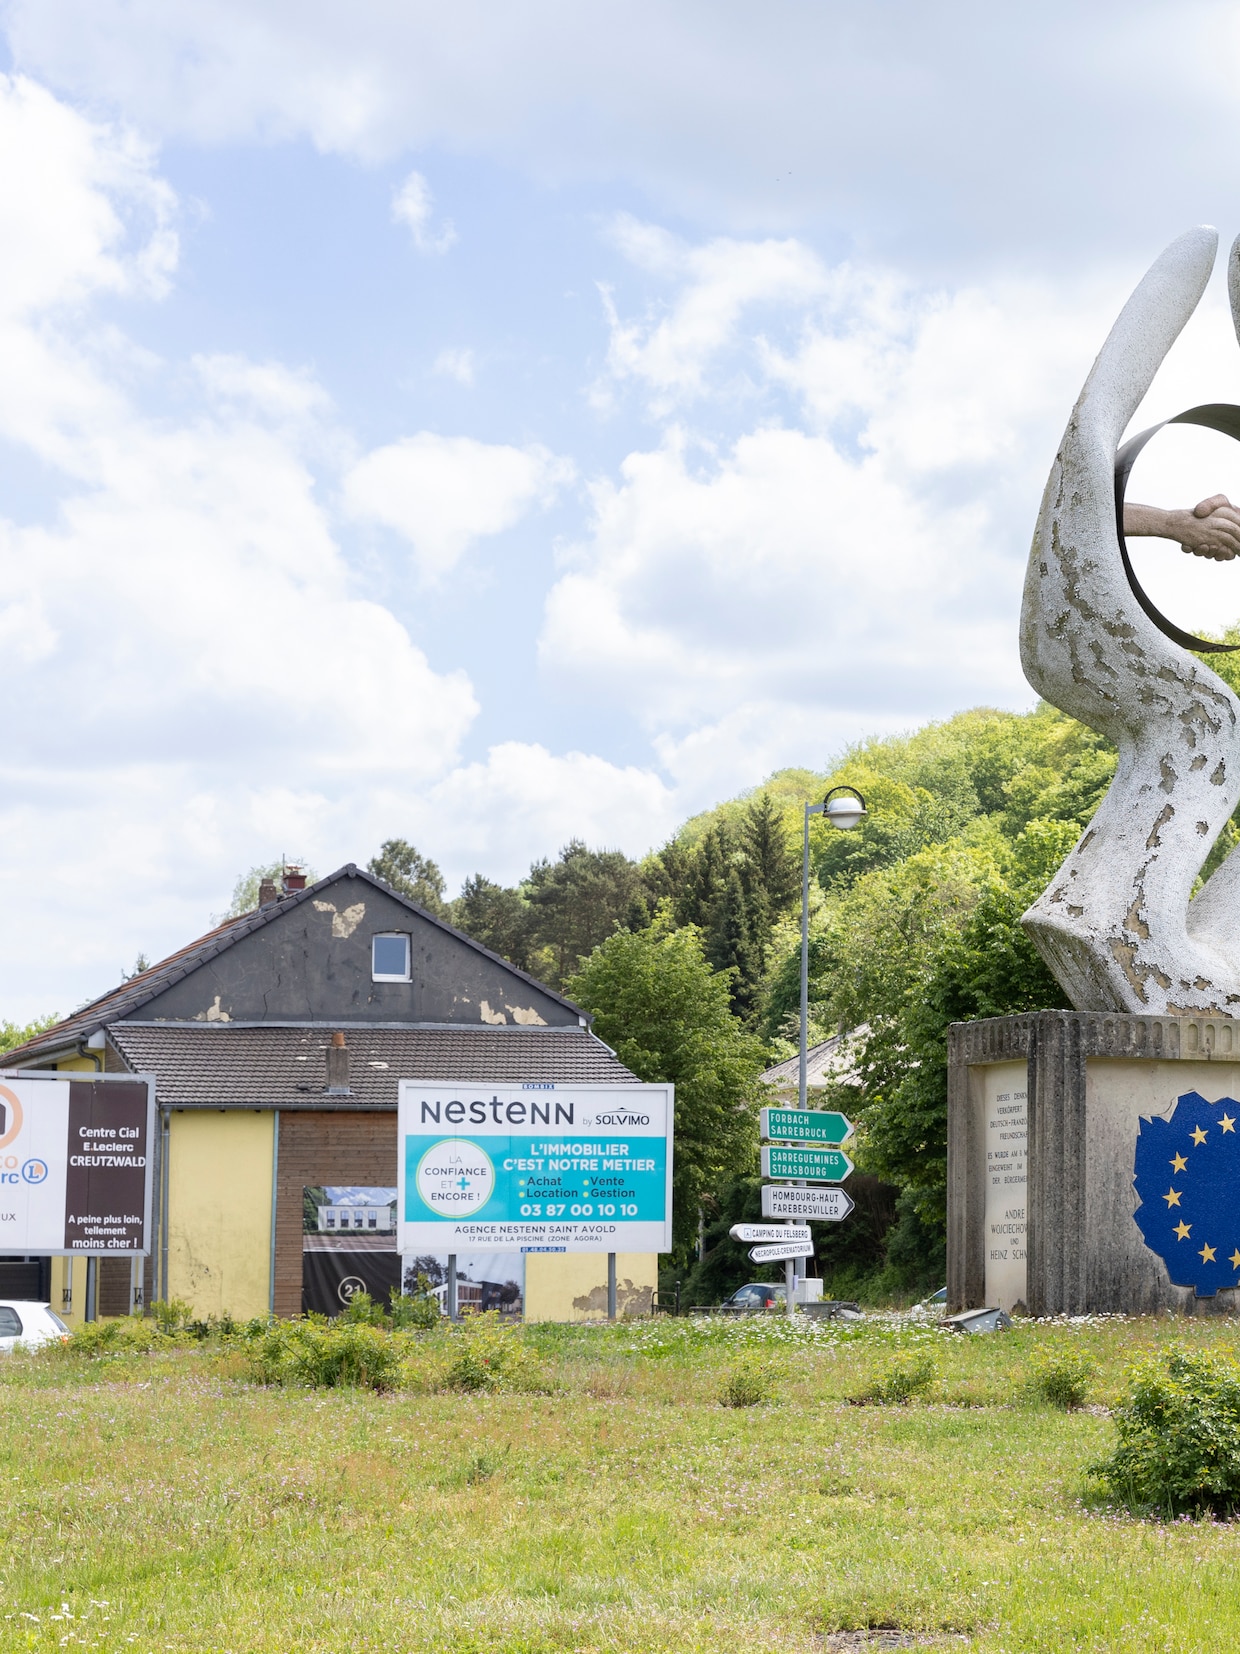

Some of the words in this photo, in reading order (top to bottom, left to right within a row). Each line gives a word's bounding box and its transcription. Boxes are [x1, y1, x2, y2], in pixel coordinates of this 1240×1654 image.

[996, 1094, 1010, 1102] DIESES
[582, 1117, 593, 1127] by
[595, 1114, 650, 1126] SOLVIMO
[770, 1113, 809, 1125] FORBACH
[79, 1126, 117, 1138] Centre
[118, 1127, 140, 1139] Cial
[771, 1126, 827, 1138] SARREBRUCK
[83, 1142, 134, 1152] E.Leclerc
[449, 1156, 462, 1164] LA
[772, 1152, 839, 1165] SARREGUEMINES
[994, 1151, 1009, 1159] WURDE
[69, 1155, 146, 1167] CREUTZWALD
[549, 1159, 599, 1171] NOTRE
[602, 1159, 656, 1171] METIER
[424, 1167, 487, 1176] CONFIANCE
[772, 1165, 827, 1176] STRASBOURG
[441, 1180, 453, 1189] ET
[527, 1176, 562, 1186] Achat
[590, 1176, 625, 1186] Vente
[992, 1177, 1001, 1185] DER
[431, 1192, 474, 1201] ENCORE
[526, 1188, 578, 1198] Location
[590, 1188, 635, 1198] Gestion
[520, 1204, 541, 1216] 03
[546, 1204, 566, 1216] 87
[570, 1204, 593, 1216] 00
[598, 1204, 616, 1216] 10
[620, 1204, 638, 1216] 10
[772, 1203, 839, 1216] FAREBERSVILLER
[1004, 1209, 1025, 1220] ANDRE
[68, 1215, 75, 1223] A
[77, 1215, 102, 1225] peine
[103, 1215, 122, 1225] plus
[123, 1215, 143, 1225] loin,
[84, 1226, 127, 1235] tellement
[455, 1226, 496, 1234] AGENCE
[500, 1226, 546, 1234] NESTENN
[581, 1225, 616, 1233] AVOLD
[752, 1229, 775, 1238] CAMPING
[775, 1230, 783, 1238] DU
[783, 1230, 809, 1239] FELSBERG
[72, 1237, 105, 1248] moins
[107, 1237, 131, 1248] cher
[547, 1235, 570, 1243] (ZONE
[574, 1235, 602, 1243] AGORA)
[990, 1250, 1008, 1260] HEINZ
